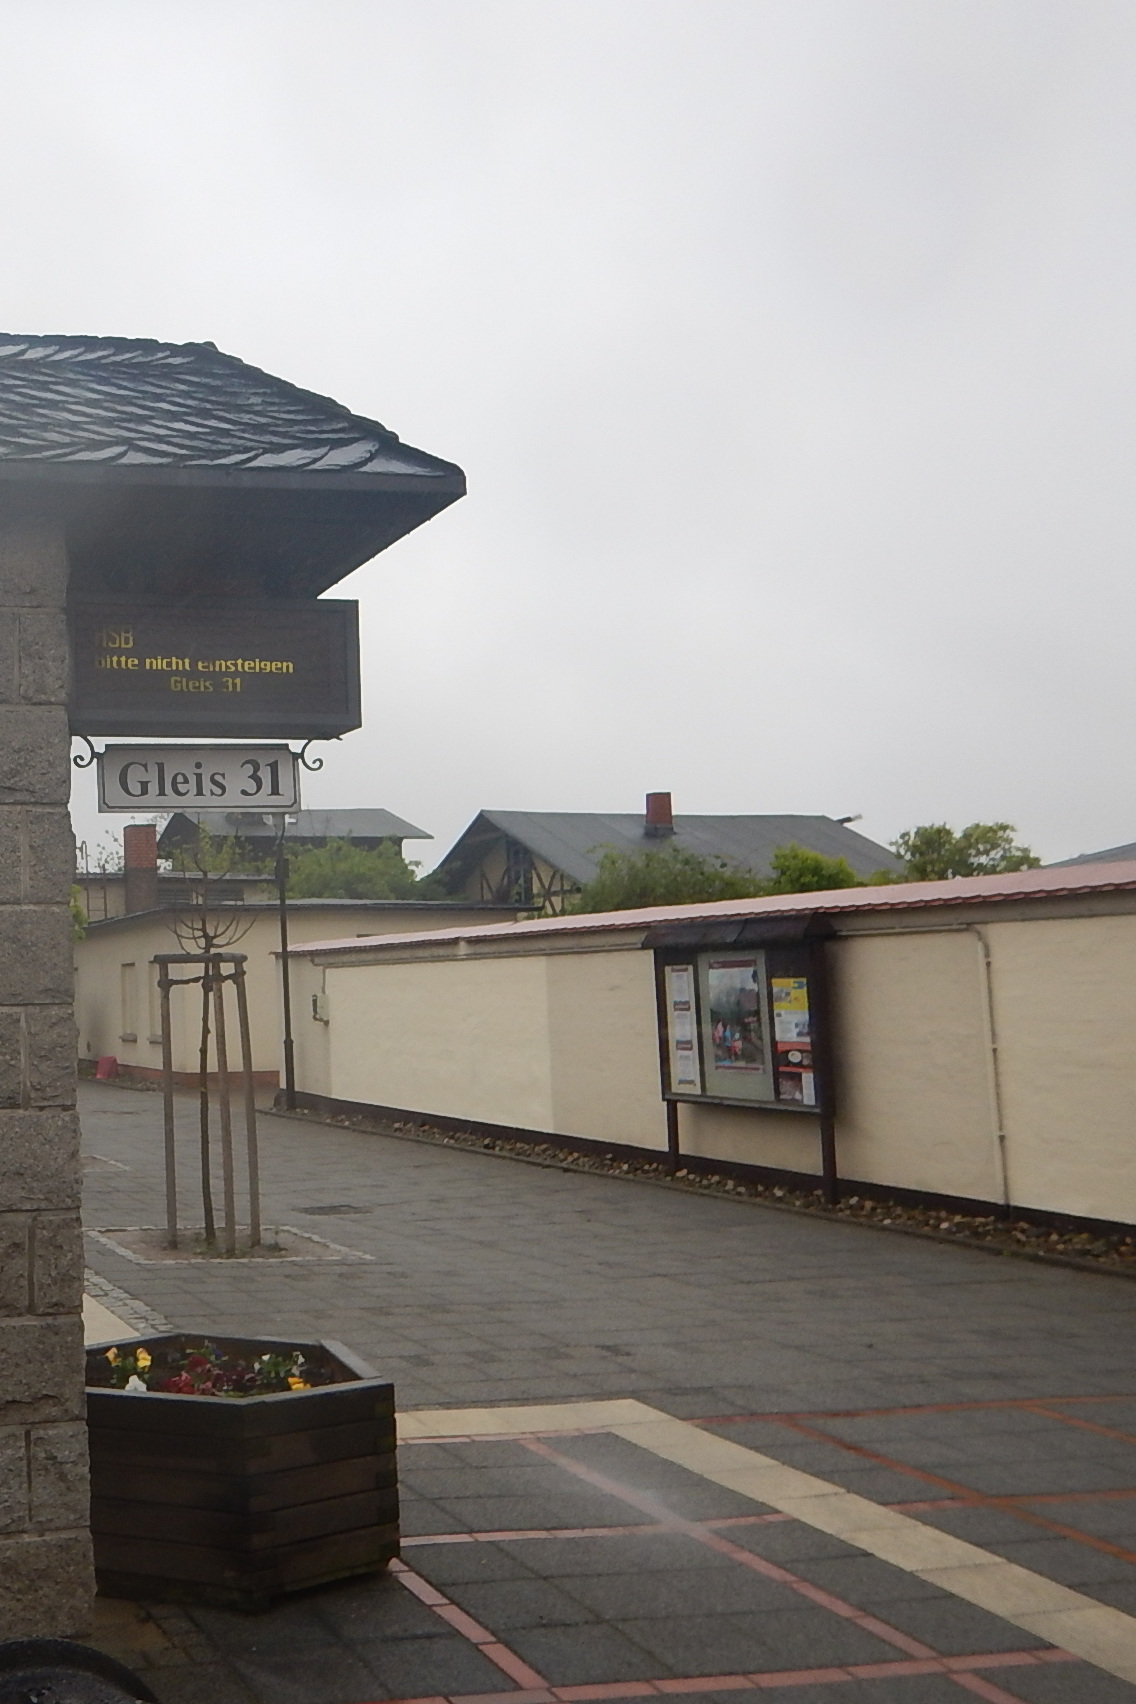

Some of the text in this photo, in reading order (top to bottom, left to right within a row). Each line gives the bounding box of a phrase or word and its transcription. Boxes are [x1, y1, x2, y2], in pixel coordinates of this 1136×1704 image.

[145, 656, 191, 671] nicht
[170, 676, 241, 692] Gleis 31
[118, 759, 284, 798] Gleis 31
